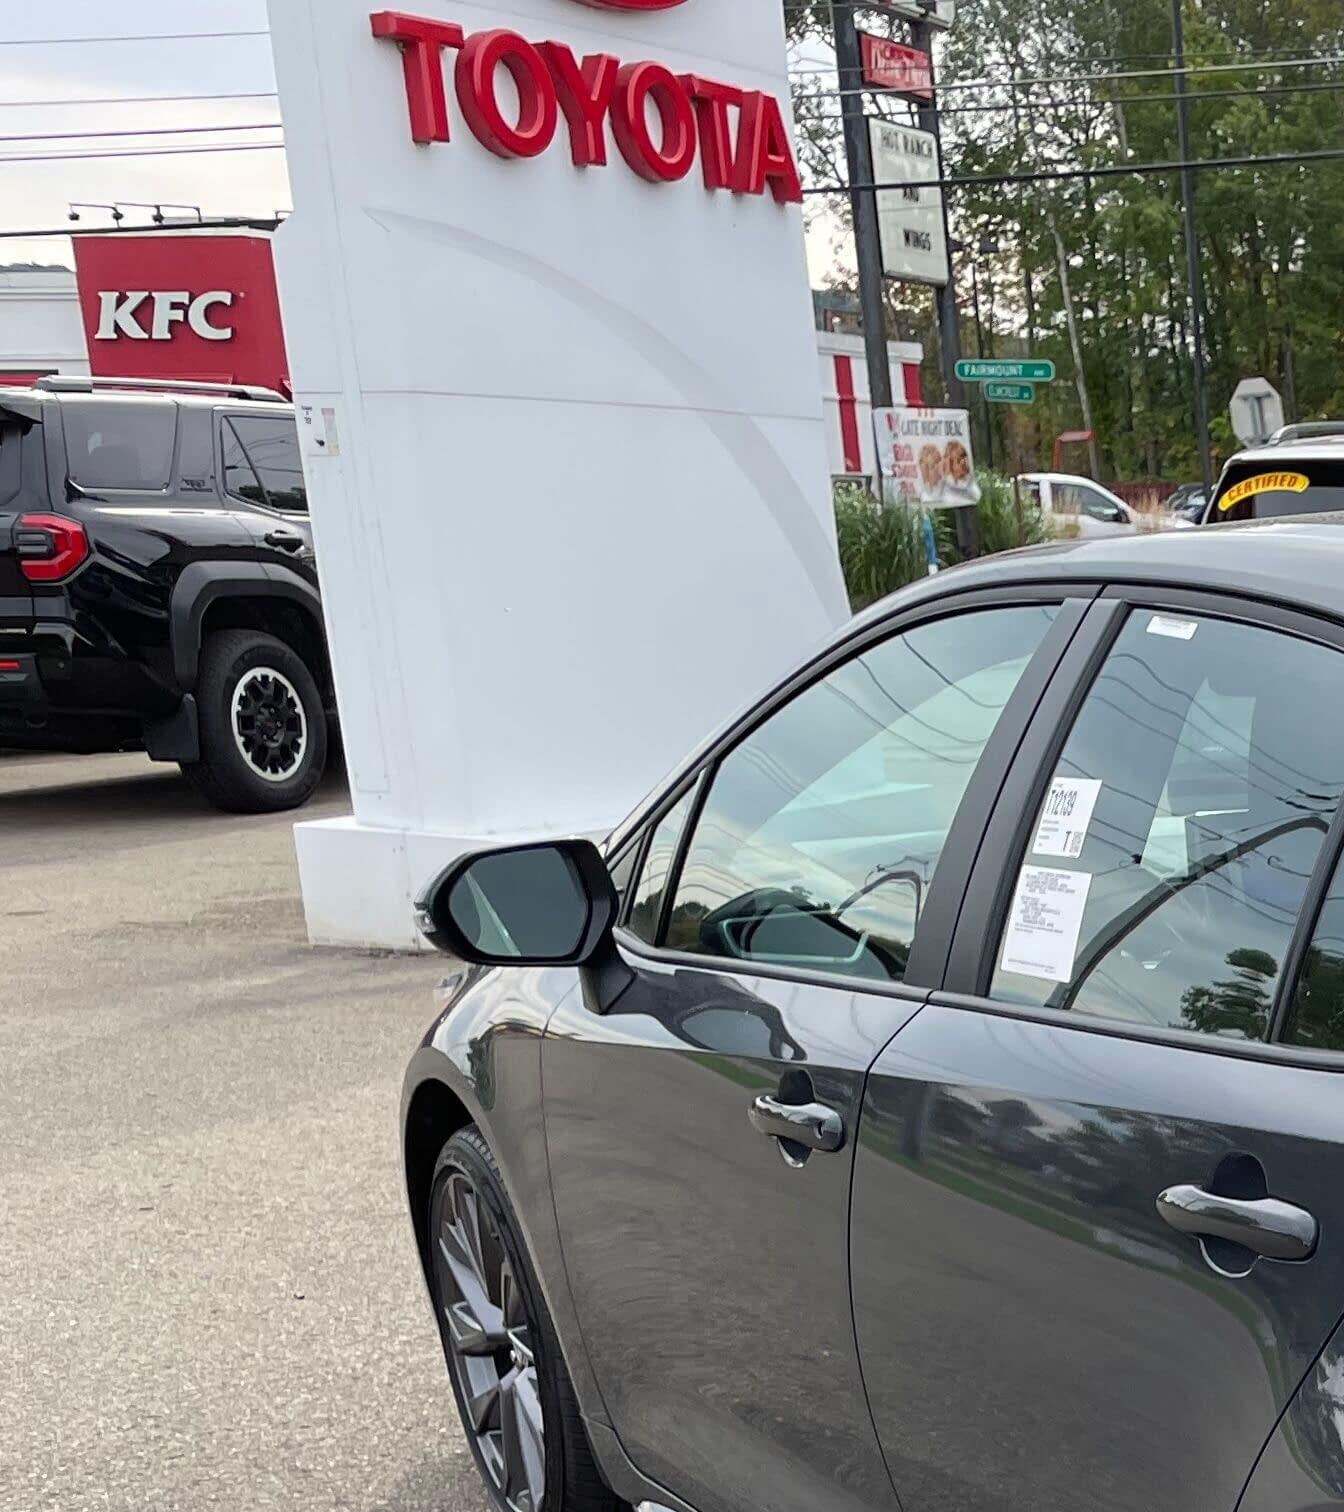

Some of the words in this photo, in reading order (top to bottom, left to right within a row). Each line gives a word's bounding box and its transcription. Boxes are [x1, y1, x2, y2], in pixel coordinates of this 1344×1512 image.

[370, 10, 803, 205] TOYOTA
[95, 291, 232, 340] KFC
[963, 364, 1023, 377] FAIRMOUNT
[921, 419, 943, 437] NIGHT
[1228, 474, 1299, 500] CERTIFIED
